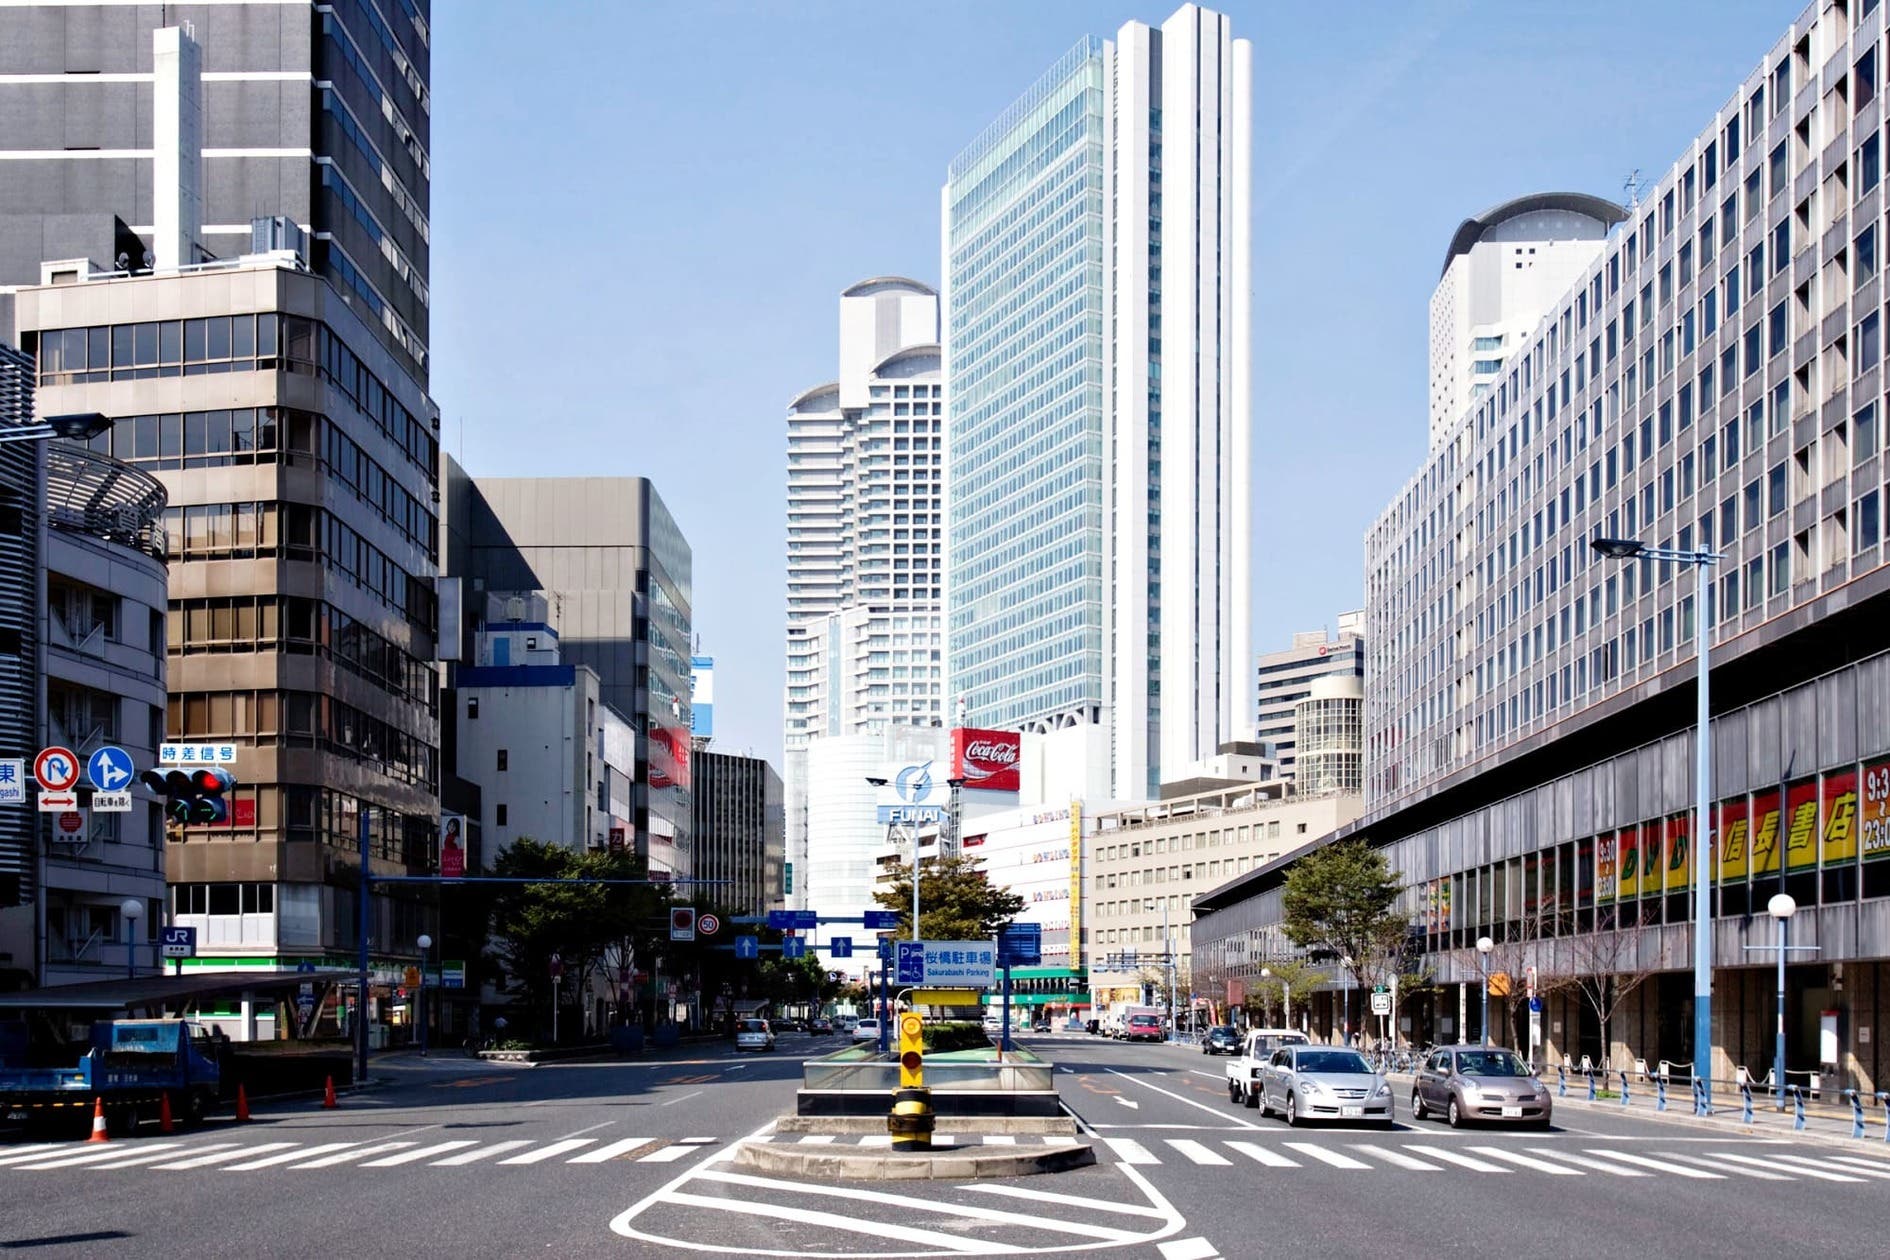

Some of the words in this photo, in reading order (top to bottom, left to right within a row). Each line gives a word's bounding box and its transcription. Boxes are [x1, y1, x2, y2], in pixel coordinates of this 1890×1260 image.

[162, 746, 234, 761] 時差信号
[0, 763, 16, 784] 東
[889, 808, 938, 822] FUNAI
[1723, 791, 1857, 862] 信長書店
[703, 920, 714, 929] 50
[165, 929, 188, 943] JR
[900, 946, 910, 960] P
[925, 951, 992, 965] 桜橋駐車場
[927, 967, 964, 977] Sakurabashi
[966, 967, 990, 978] Parking
